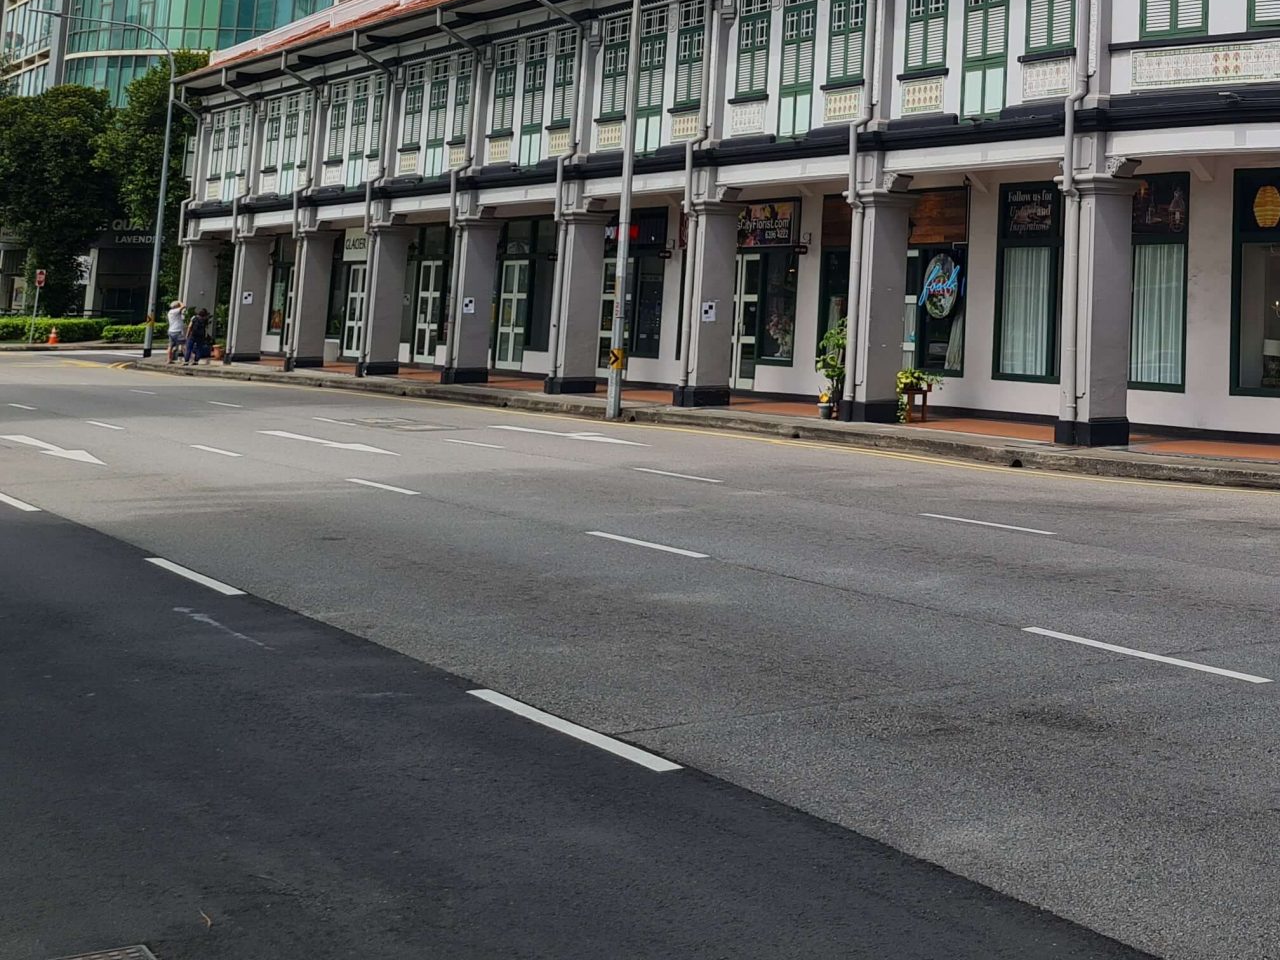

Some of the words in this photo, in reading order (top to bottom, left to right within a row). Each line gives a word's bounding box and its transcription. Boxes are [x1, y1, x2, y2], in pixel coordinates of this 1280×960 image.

[1008, 191, 1031, 202] Follow
[1033, 192, 1041, 201] us
[1042, 189, 1052, 201] for
[1036, 204, 1052, 217] and
[115, 235, 166, 244] LAVENDR
